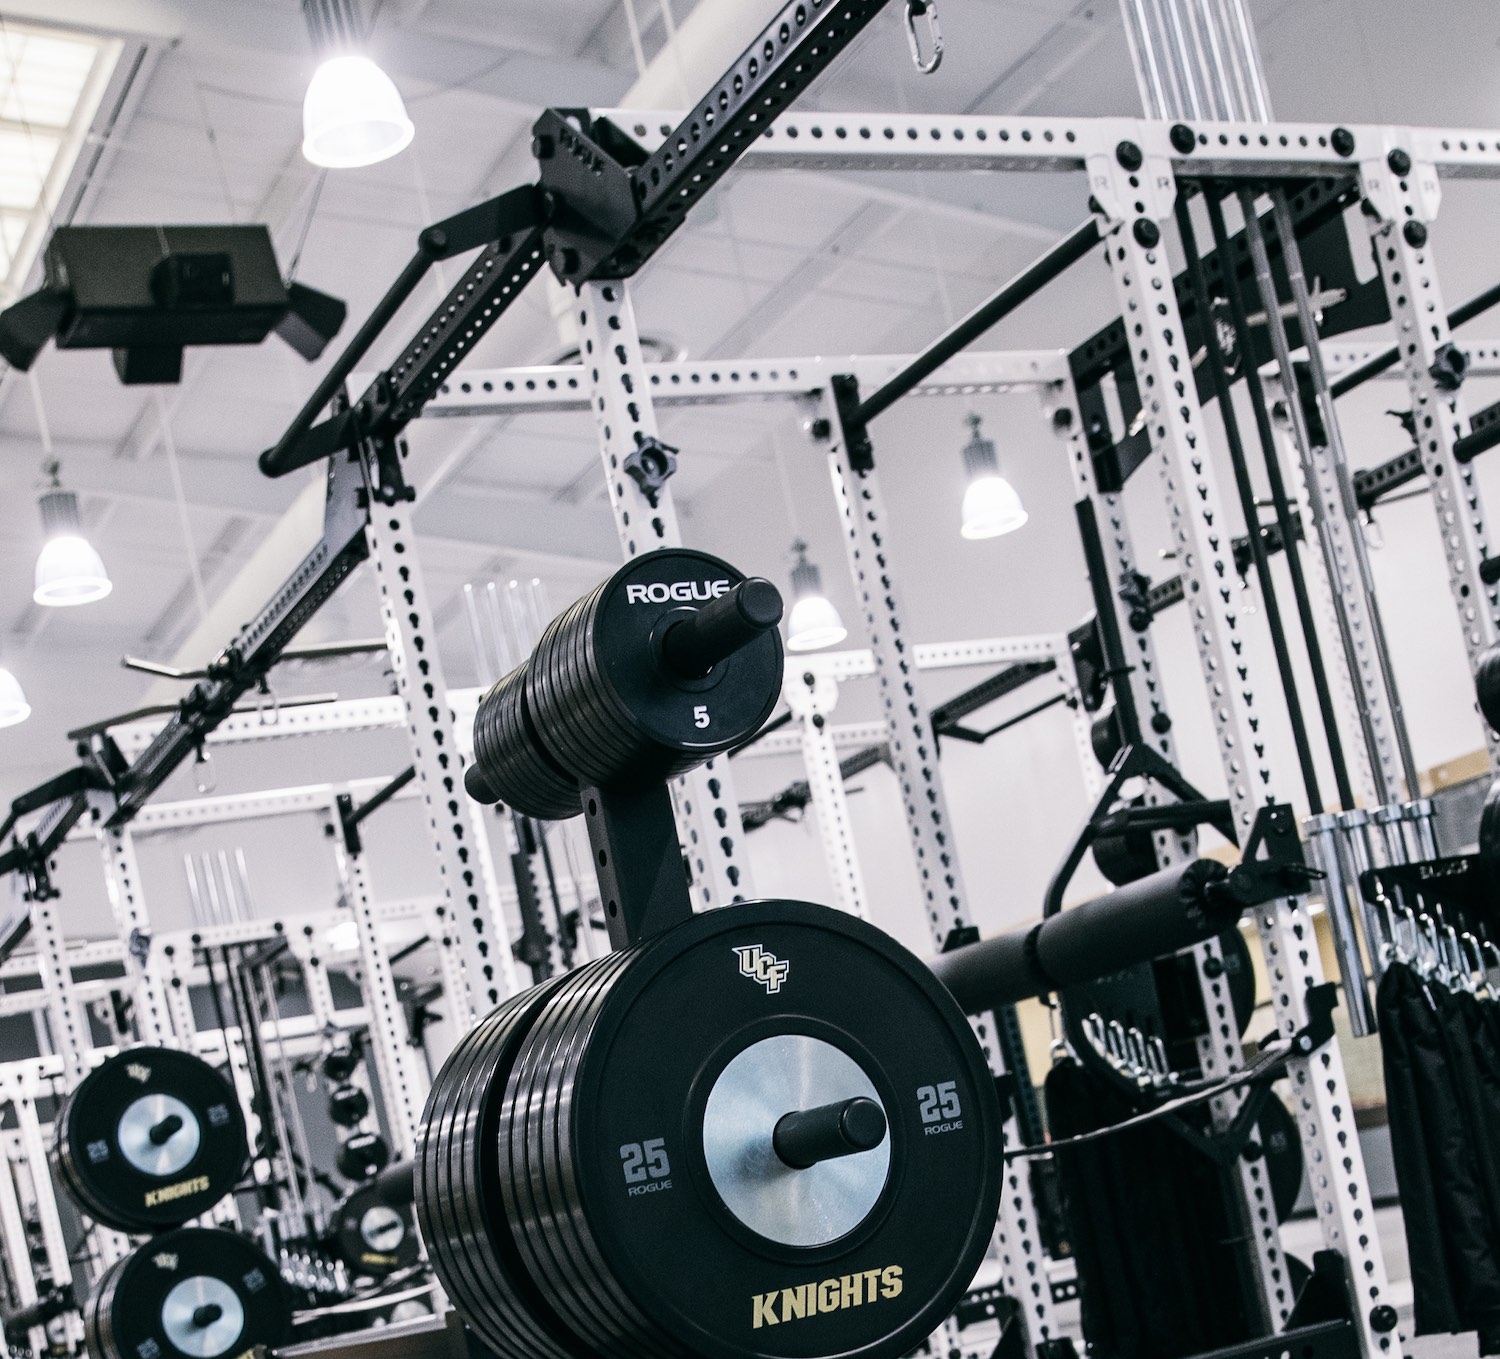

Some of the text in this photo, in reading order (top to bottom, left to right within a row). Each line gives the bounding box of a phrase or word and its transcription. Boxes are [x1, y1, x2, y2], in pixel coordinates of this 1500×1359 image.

[626, 579, 731, 604] ROGUE
[693, 705, 711, 729] 5
[731, 944, 790, 994] UCF
[916, 1080, 962, 1124] 25
[924, 1120, 963, 1136] ROGUE
[619, 1137, 671, 1184] 25
[628, 1180, 673, 1197] ROGUE
[751, 1264, 904, 1329] KNIGHTS
